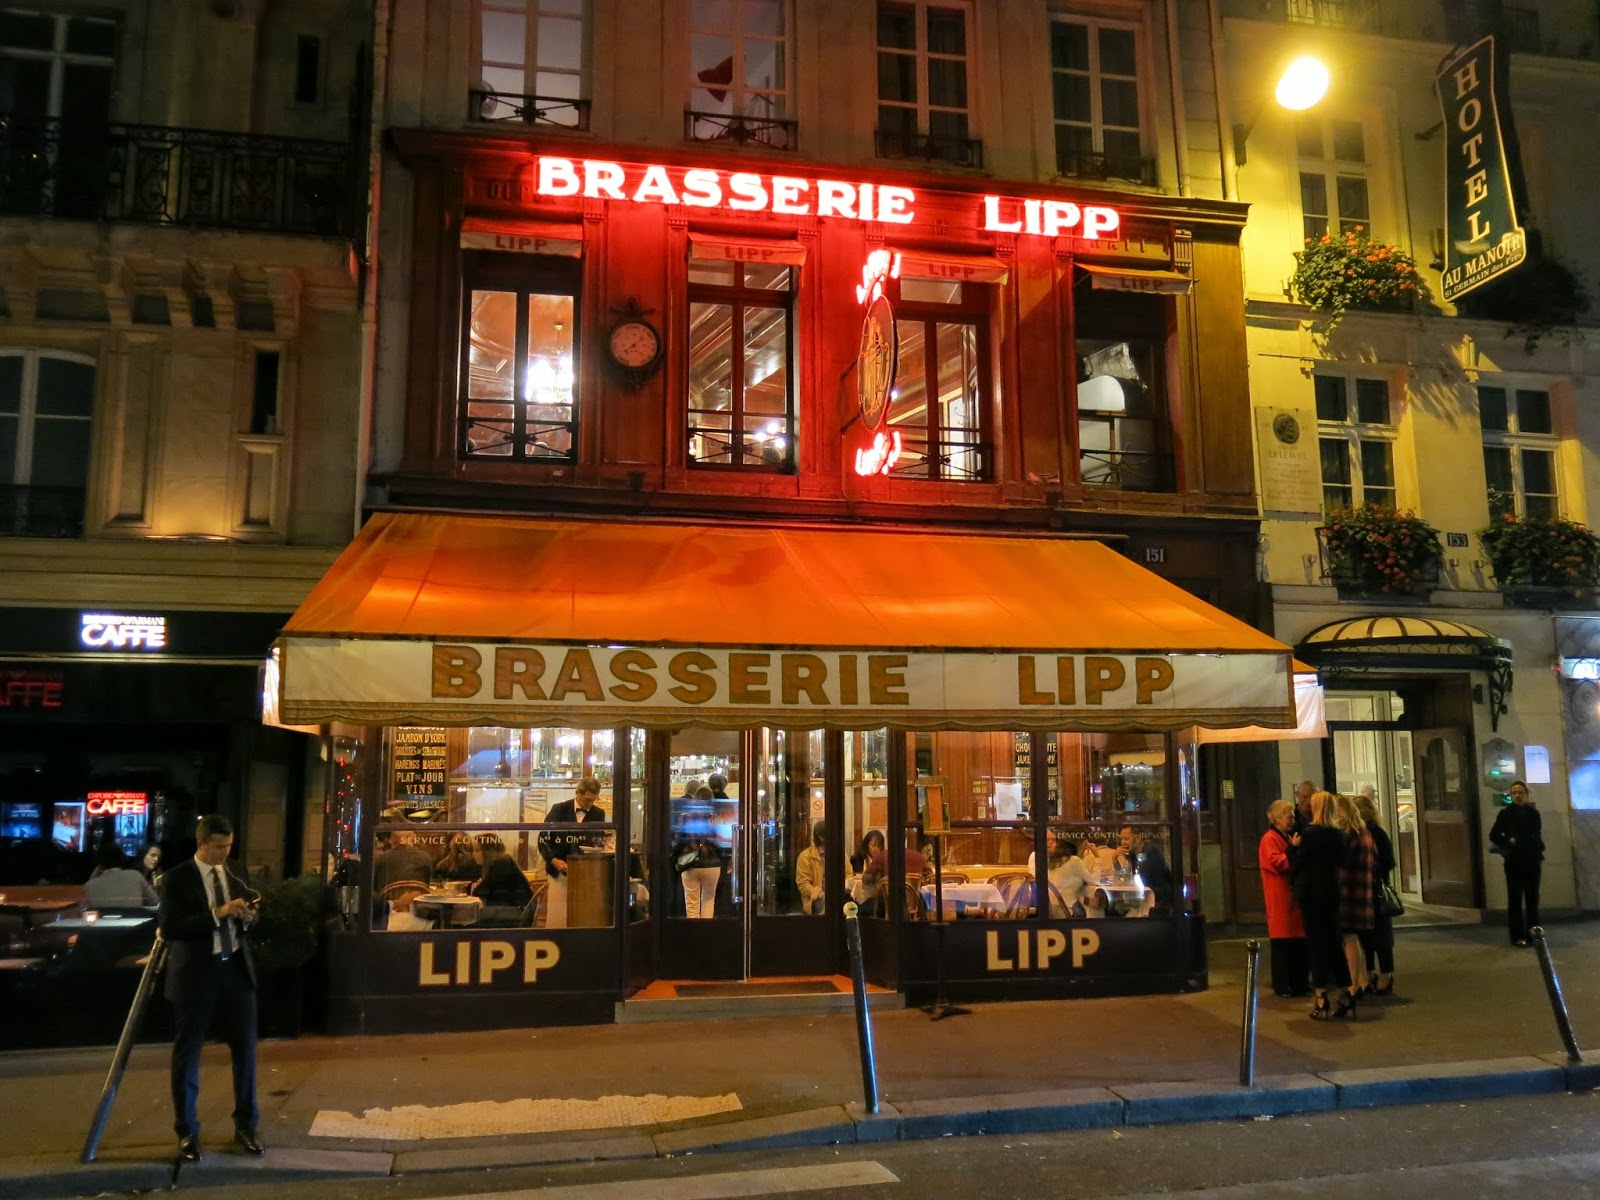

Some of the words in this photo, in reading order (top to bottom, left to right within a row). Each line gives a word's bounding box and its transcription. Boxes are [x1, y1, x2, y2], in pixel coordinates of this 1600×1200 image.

[1453, 58, 1490, 244] HOTEL
[537, 157, 915, 224] BRASSERIE
[984, 196, 1119, 239] LIPP
[495, 235, 547, 251] LIPP
[724, 246, 774, 260] LIPP
[1444, 266, 1461, 289] AU
[1465, 234, 1522, 278] MANOIR
[928, 263, 976, 279] LIPP
[1121, 277, 1164, 291] LIPP
[1454, 269, 1490, 293] GERMAIN
[1449, 534, 1467, 546] 153
[1146, 548, 1164, 562] 151
[81, 624, 165, 646] CAFFE
[432, 644, 909, 706] BRASSERIE
[1017, 655, 1175, 705] LIPP
[396, 772, 415, 783] PLAT
[421, 772, 443, 783] JOUR
[406, 784, 433, 795] VINS
[86, 799, 146, 814] CAFFE
[400, 836, 446, 845] SERVICE
[986, 928, 1100, 971] LIPP
[420, 940, 560, 985] LIPP
